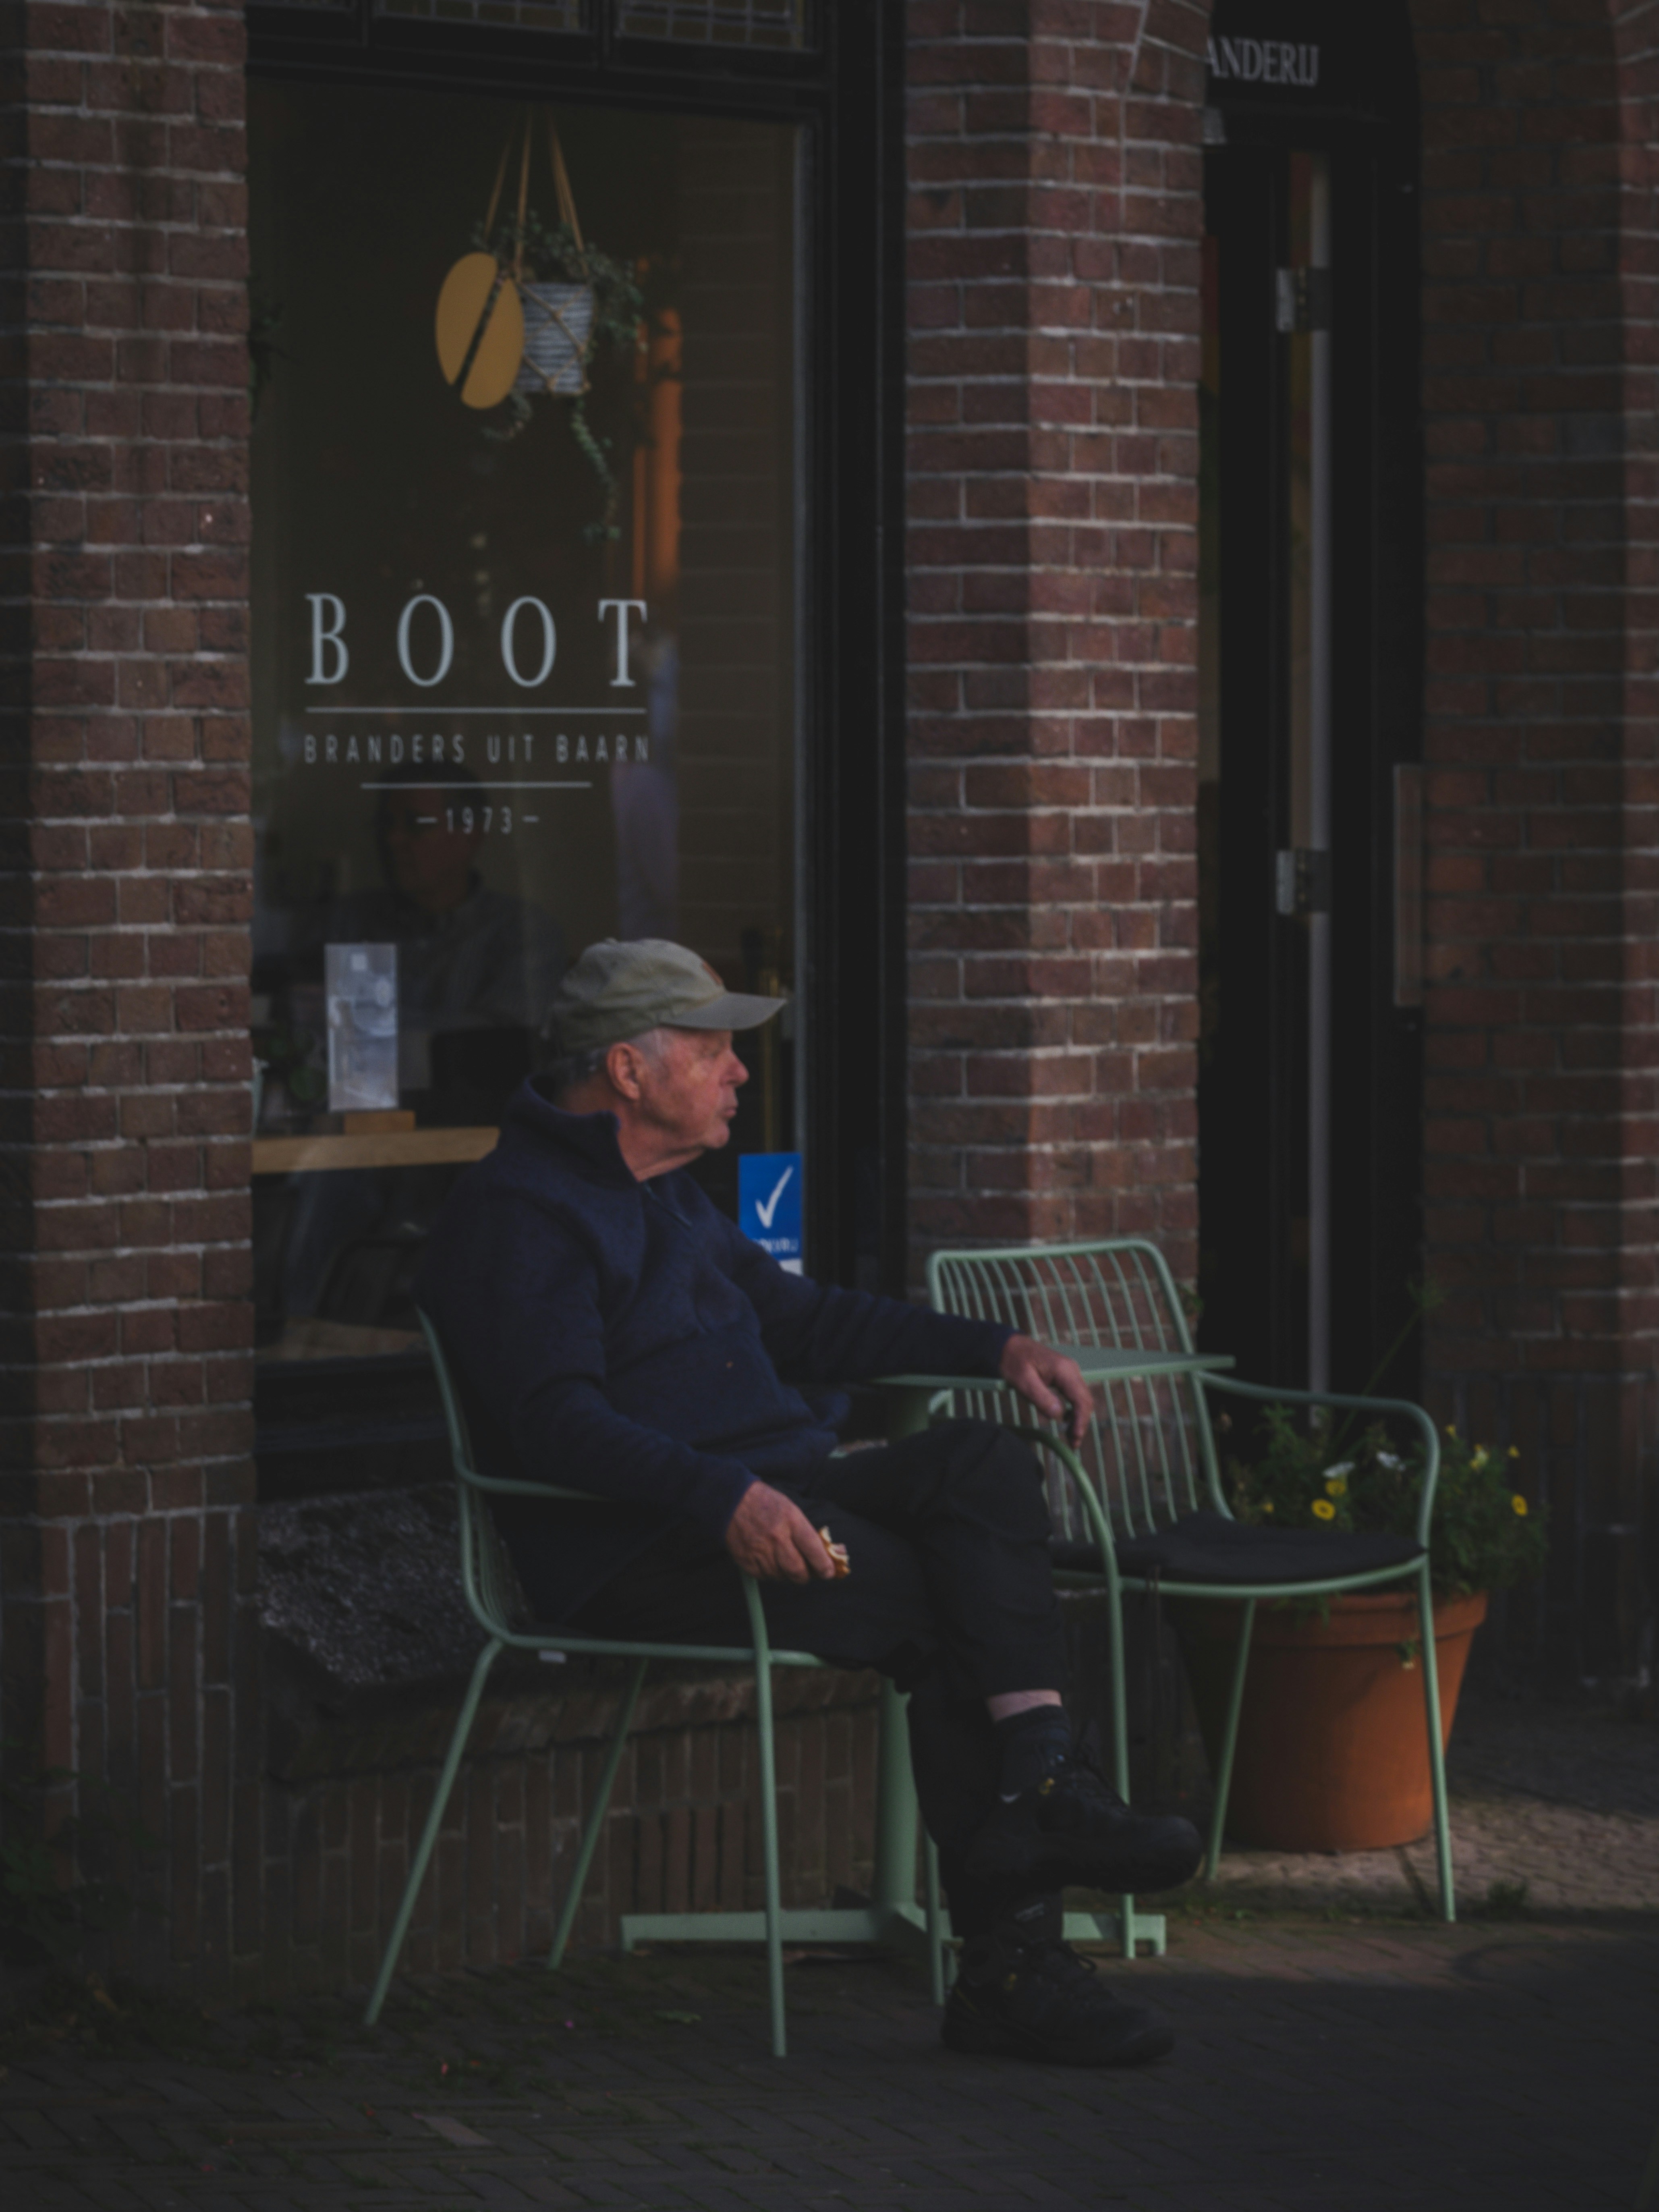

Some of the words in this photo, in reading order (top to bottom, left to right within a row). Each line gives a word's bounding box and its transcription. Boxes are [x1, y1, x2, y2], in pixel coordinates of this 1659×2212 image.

[305, 593, 647, 687] BOOT
[304, 734, 465, 763] BRANDERS
[487, 734, 534, 763] UIT
[556, 734, 649, 763] BAARN
